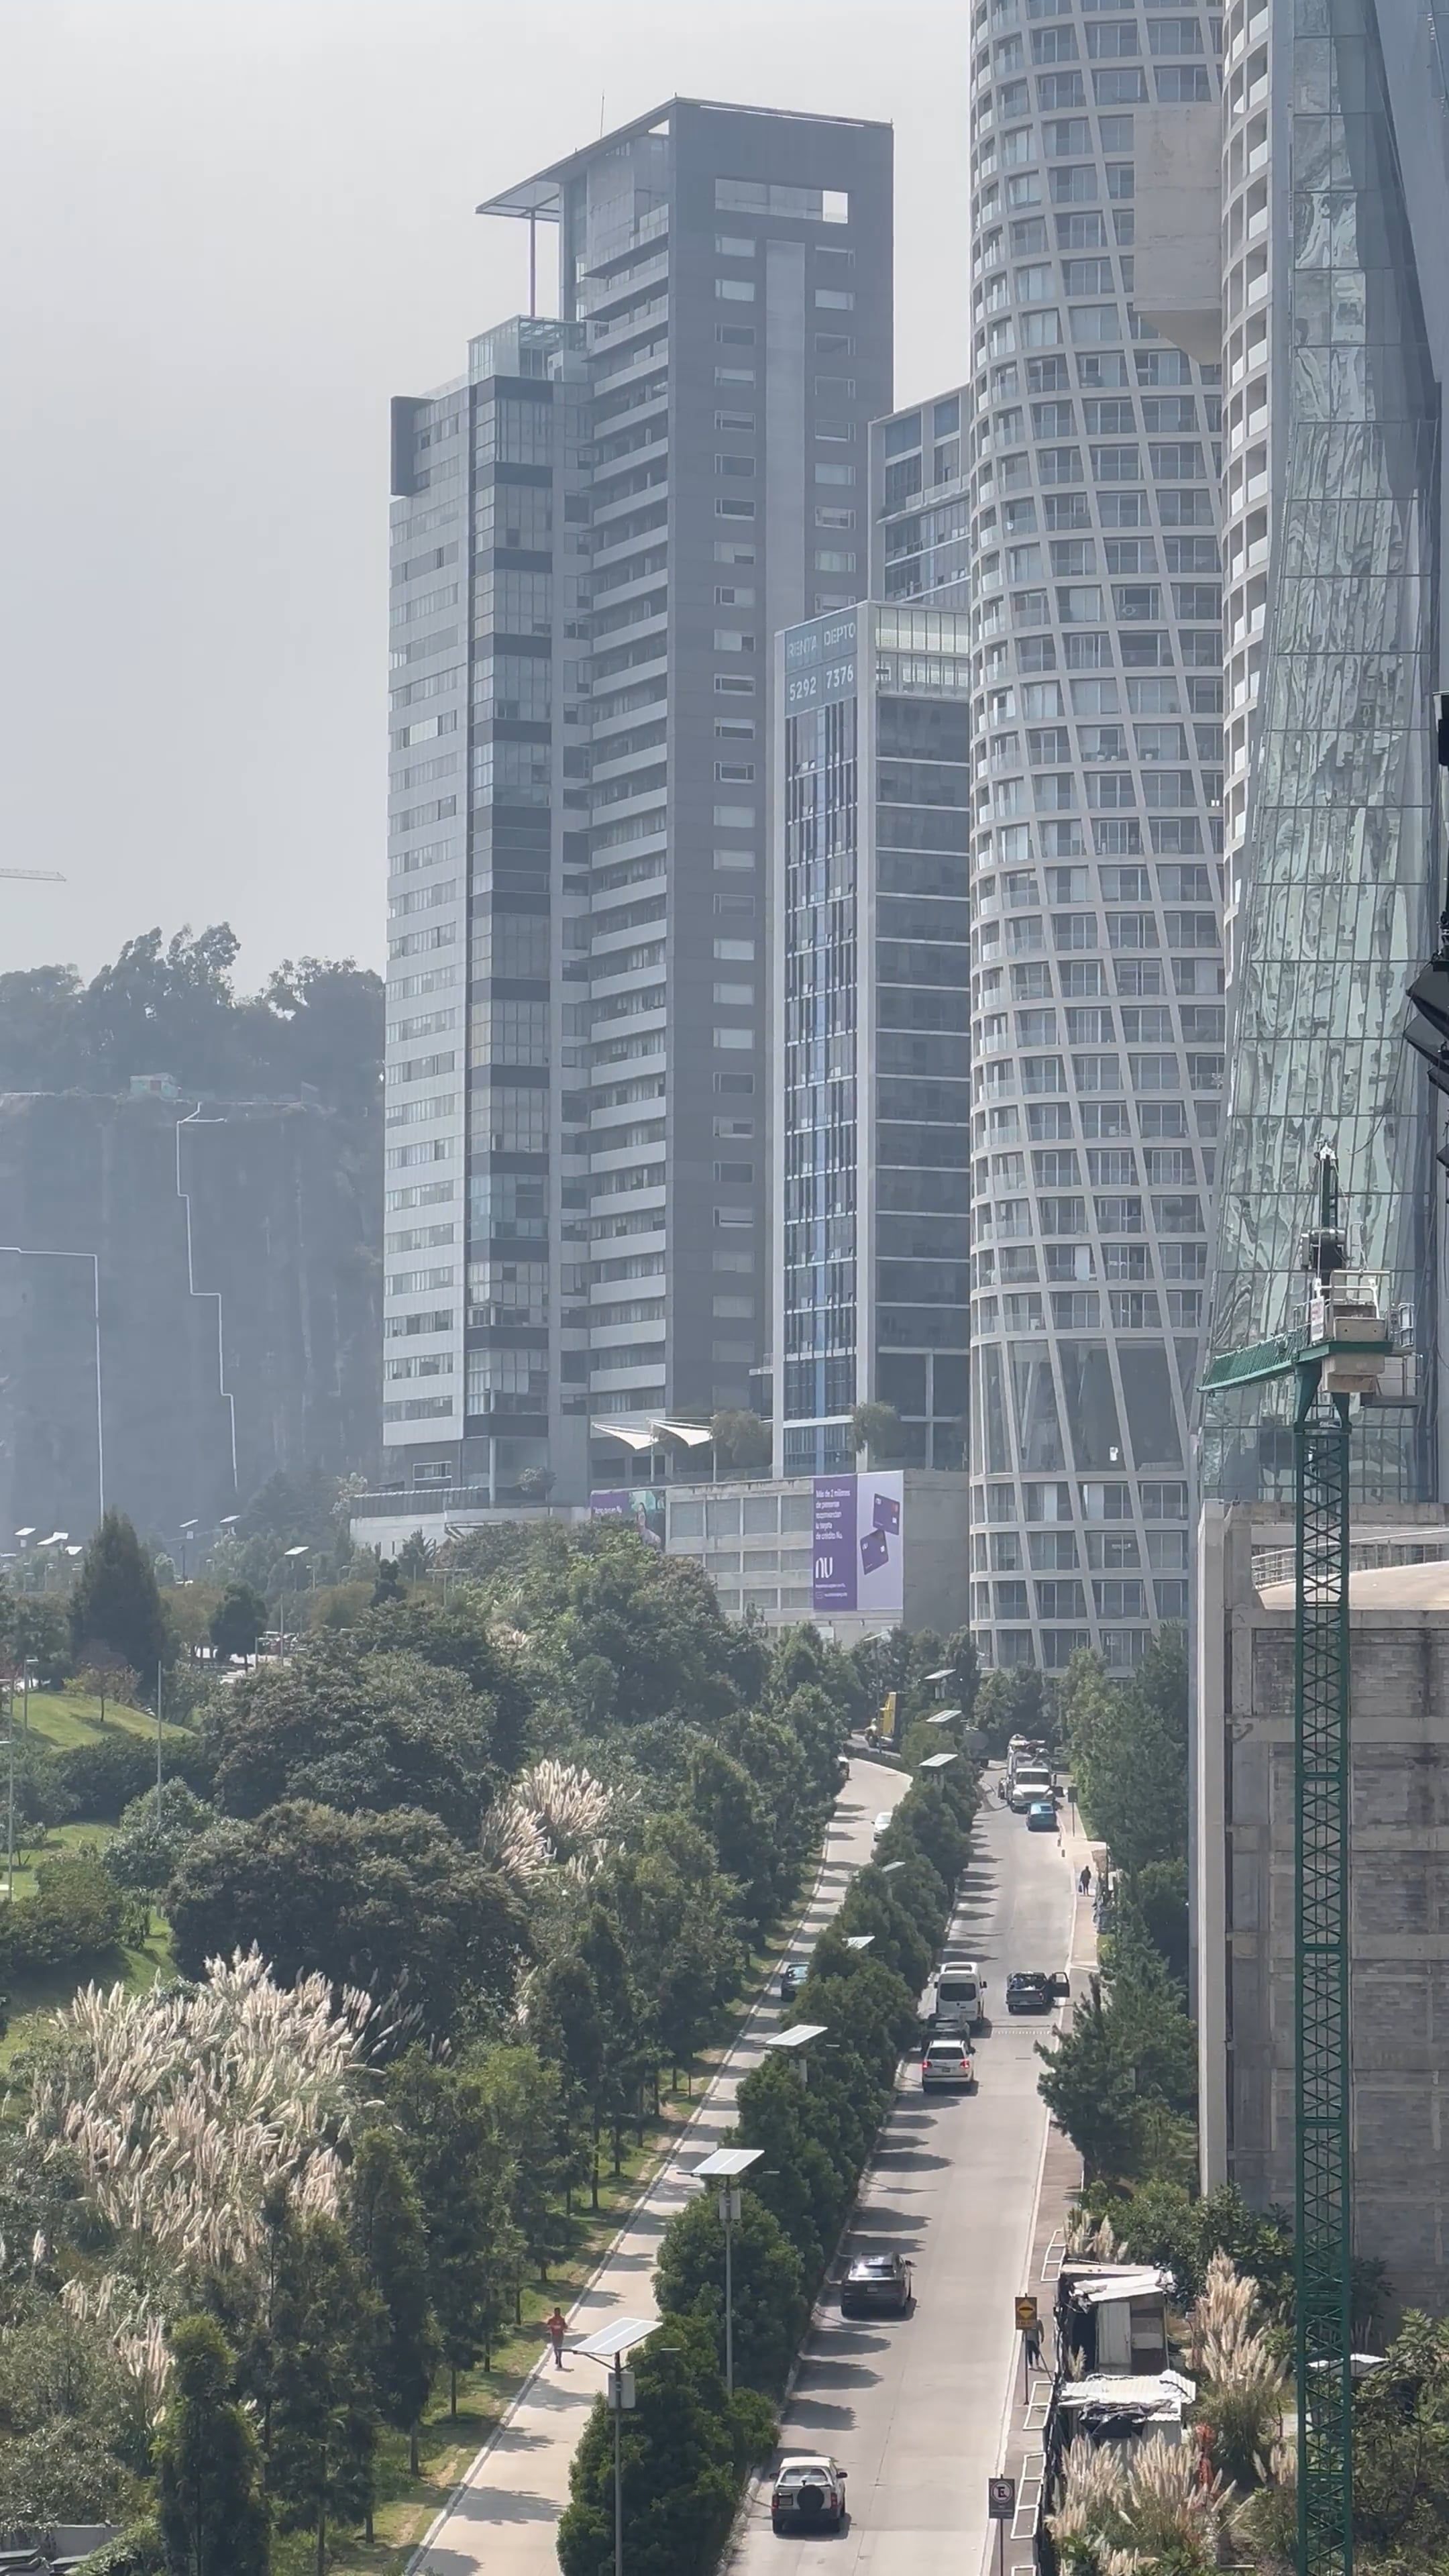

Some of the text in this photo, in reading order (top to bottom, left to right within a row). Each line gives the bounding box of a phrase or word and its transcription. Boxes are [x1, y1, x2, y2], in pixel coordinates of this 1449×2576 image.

[789, 623, 855, 657] RENTA DEPTO
[790, 664, 853, 701] 5292 7376
[998, 2486, 1007, 2498] E
